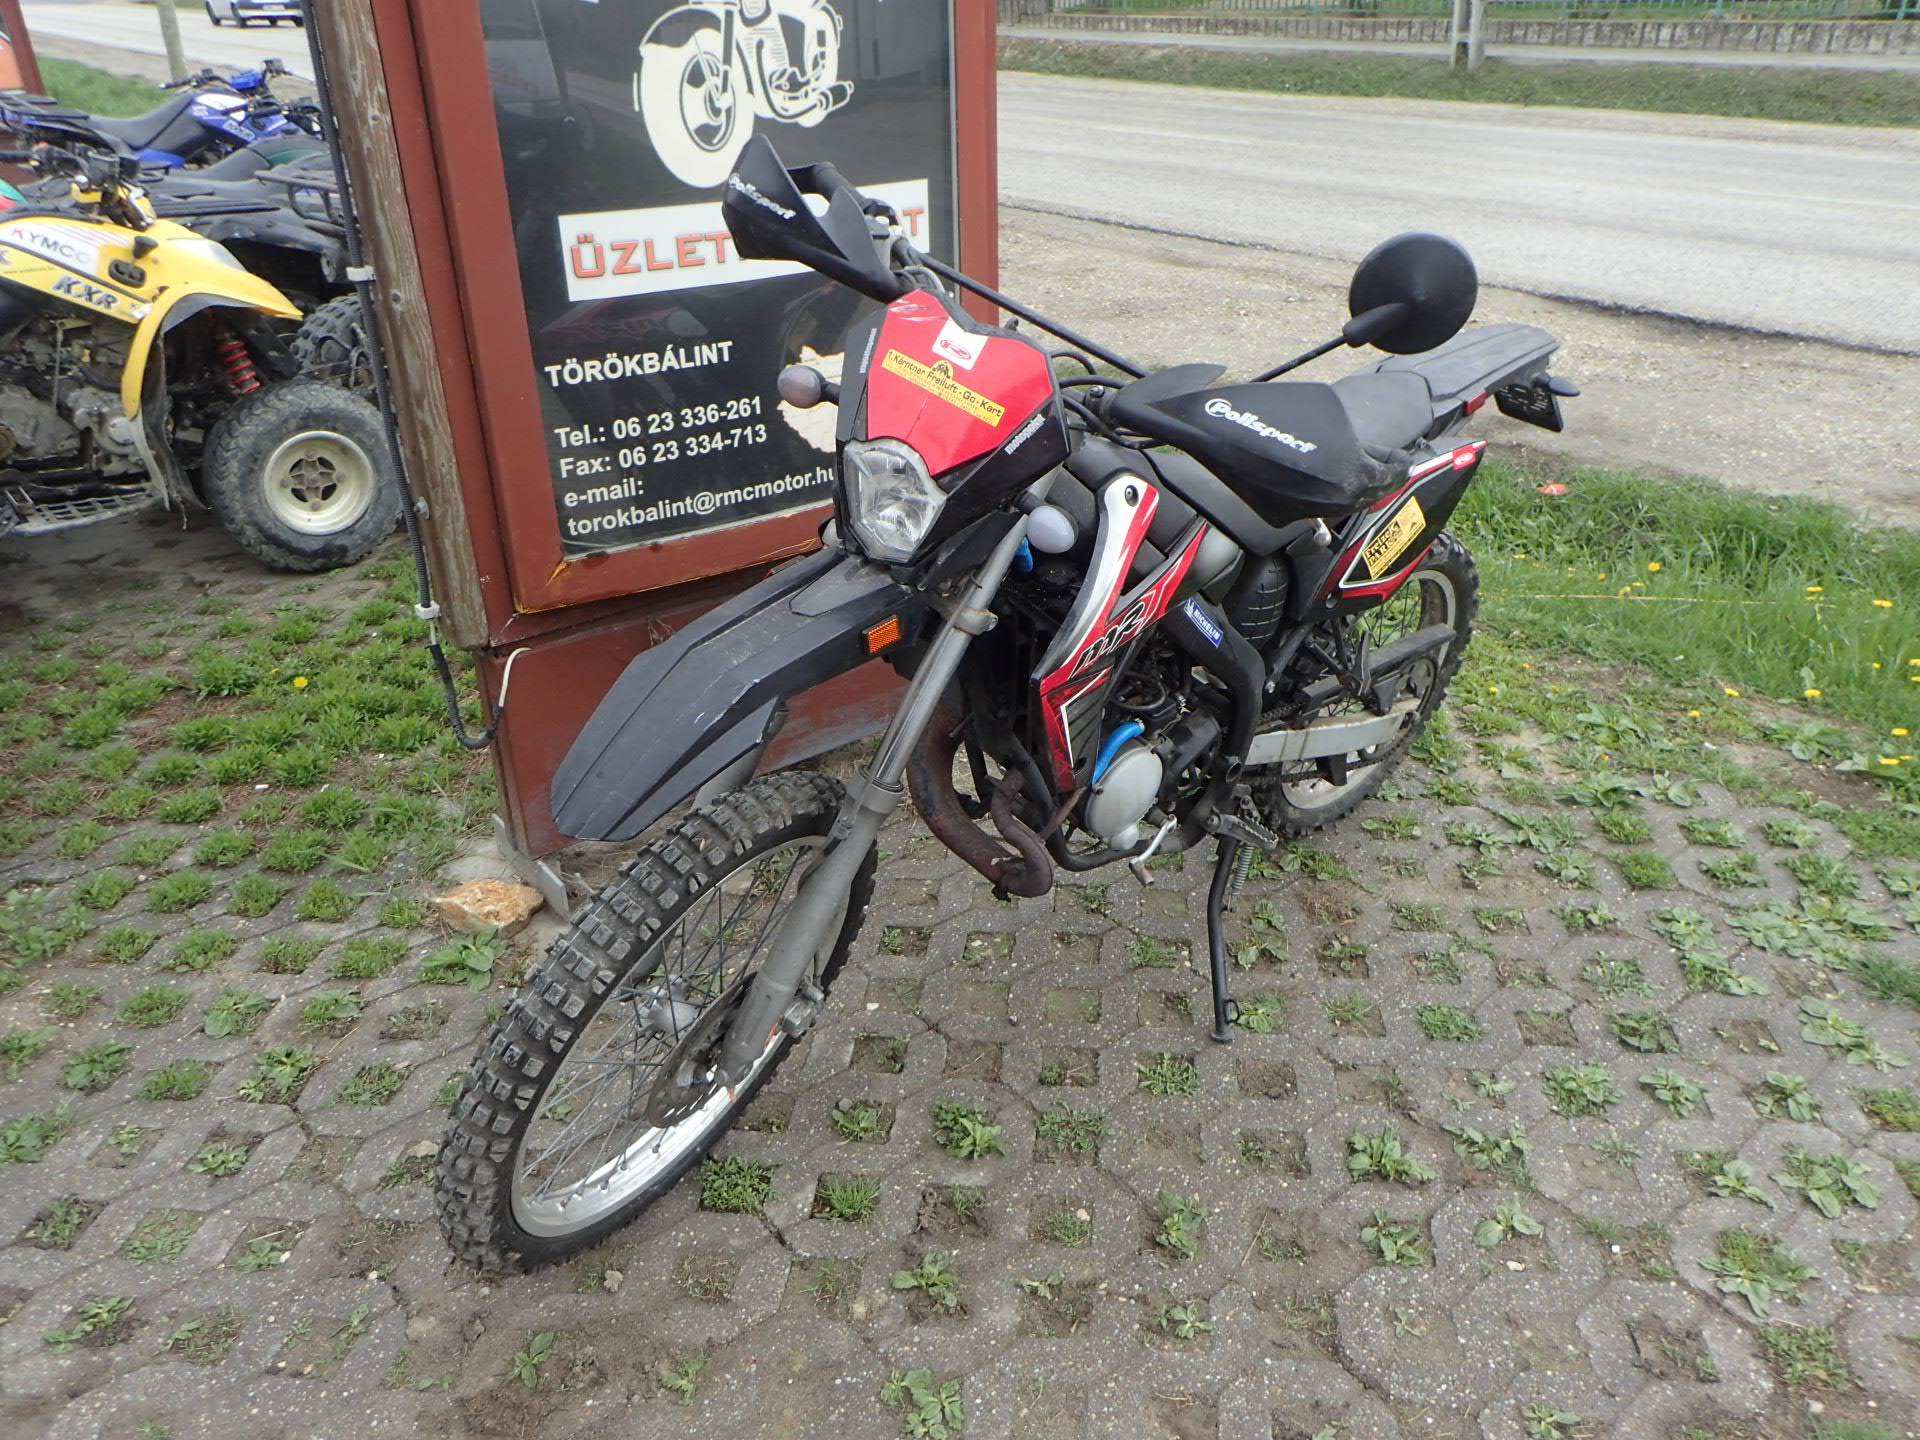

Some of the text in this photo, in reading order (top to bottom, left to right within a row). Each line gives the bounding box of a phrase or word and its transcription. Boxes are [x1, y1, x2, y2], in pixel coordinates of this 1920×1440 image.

[11, 227, 90, 264] KYMCO
[571, 231, 743, 278] ÜZLET
[52, 275, 118, 309] KXR
[544, 341, 733, 387] TÖRÖKBÁLINT
[554, 396, 761, 448] Tel.: 06 23 336-261
[1205, 398, 1317, 453] Polisport
[559, 424, 767, 478] Fax: 06 23 334-713
[564, 477, 644, 507] e-mail:
[1193, 608, 1221, 641] MICHELIN
